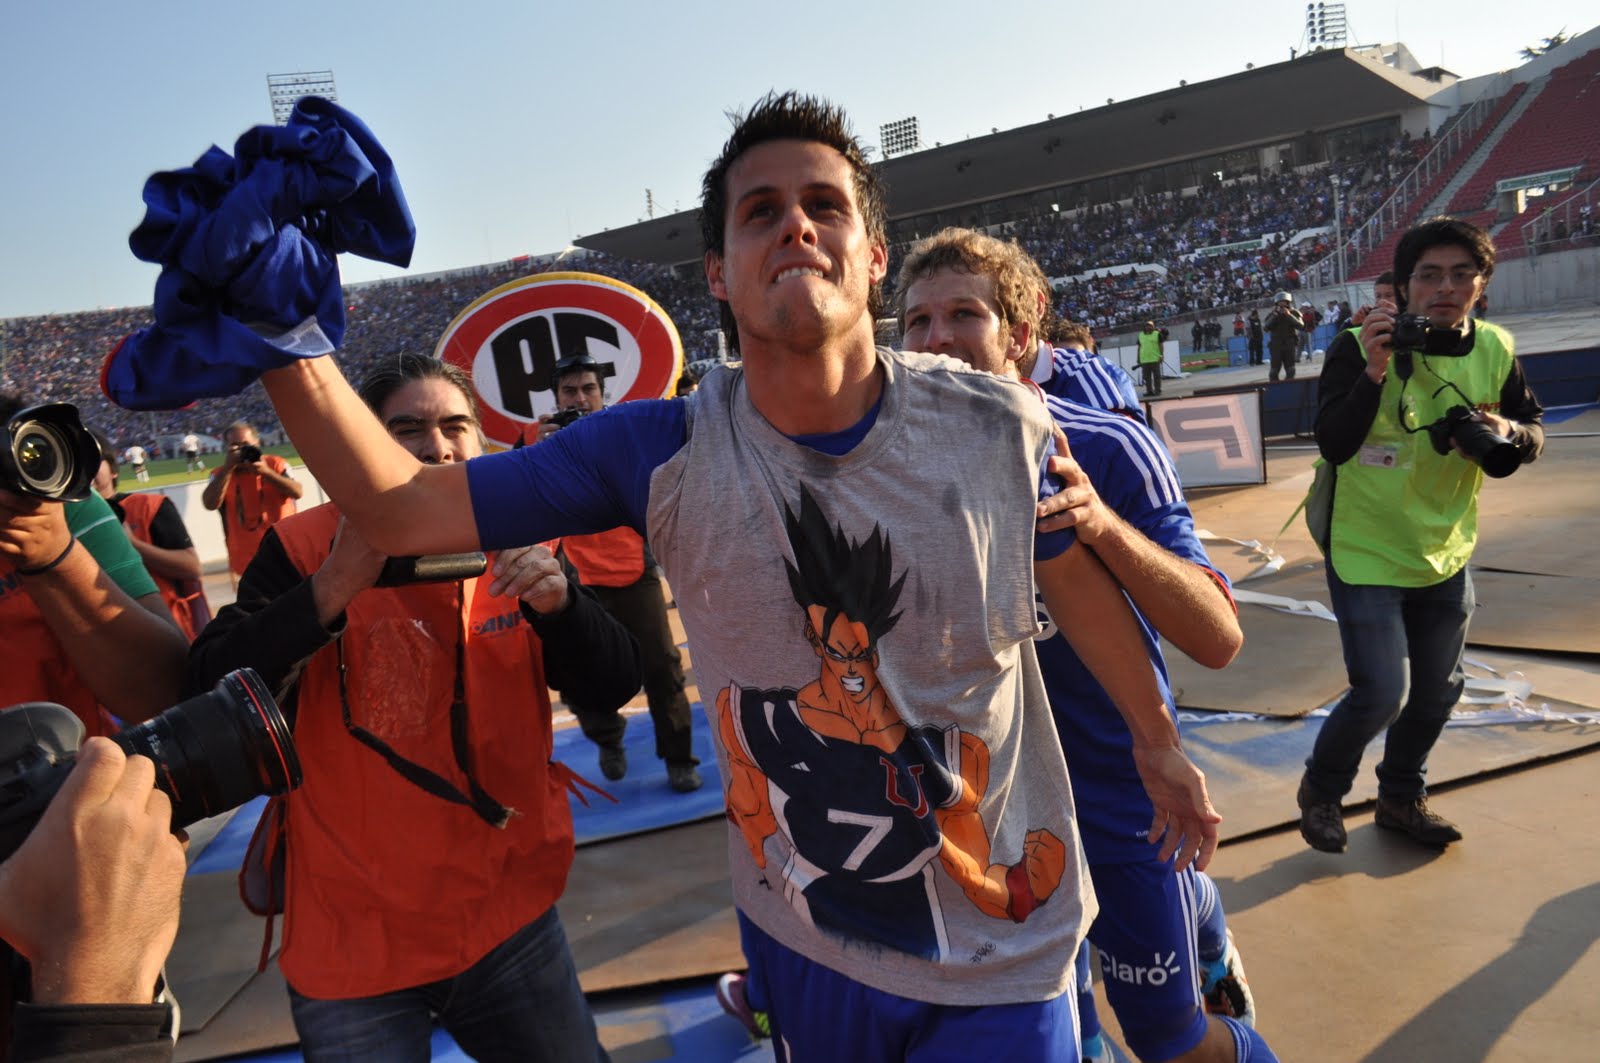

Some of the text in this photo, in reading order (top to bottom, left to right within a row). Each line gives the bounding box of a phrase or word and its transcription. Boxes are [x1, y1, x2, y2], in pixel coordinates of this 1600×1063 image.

[490, 312, 621, 419] PF
[827, 808, 893, 871] 7
[1098, 948, 1168, 986] Claro
